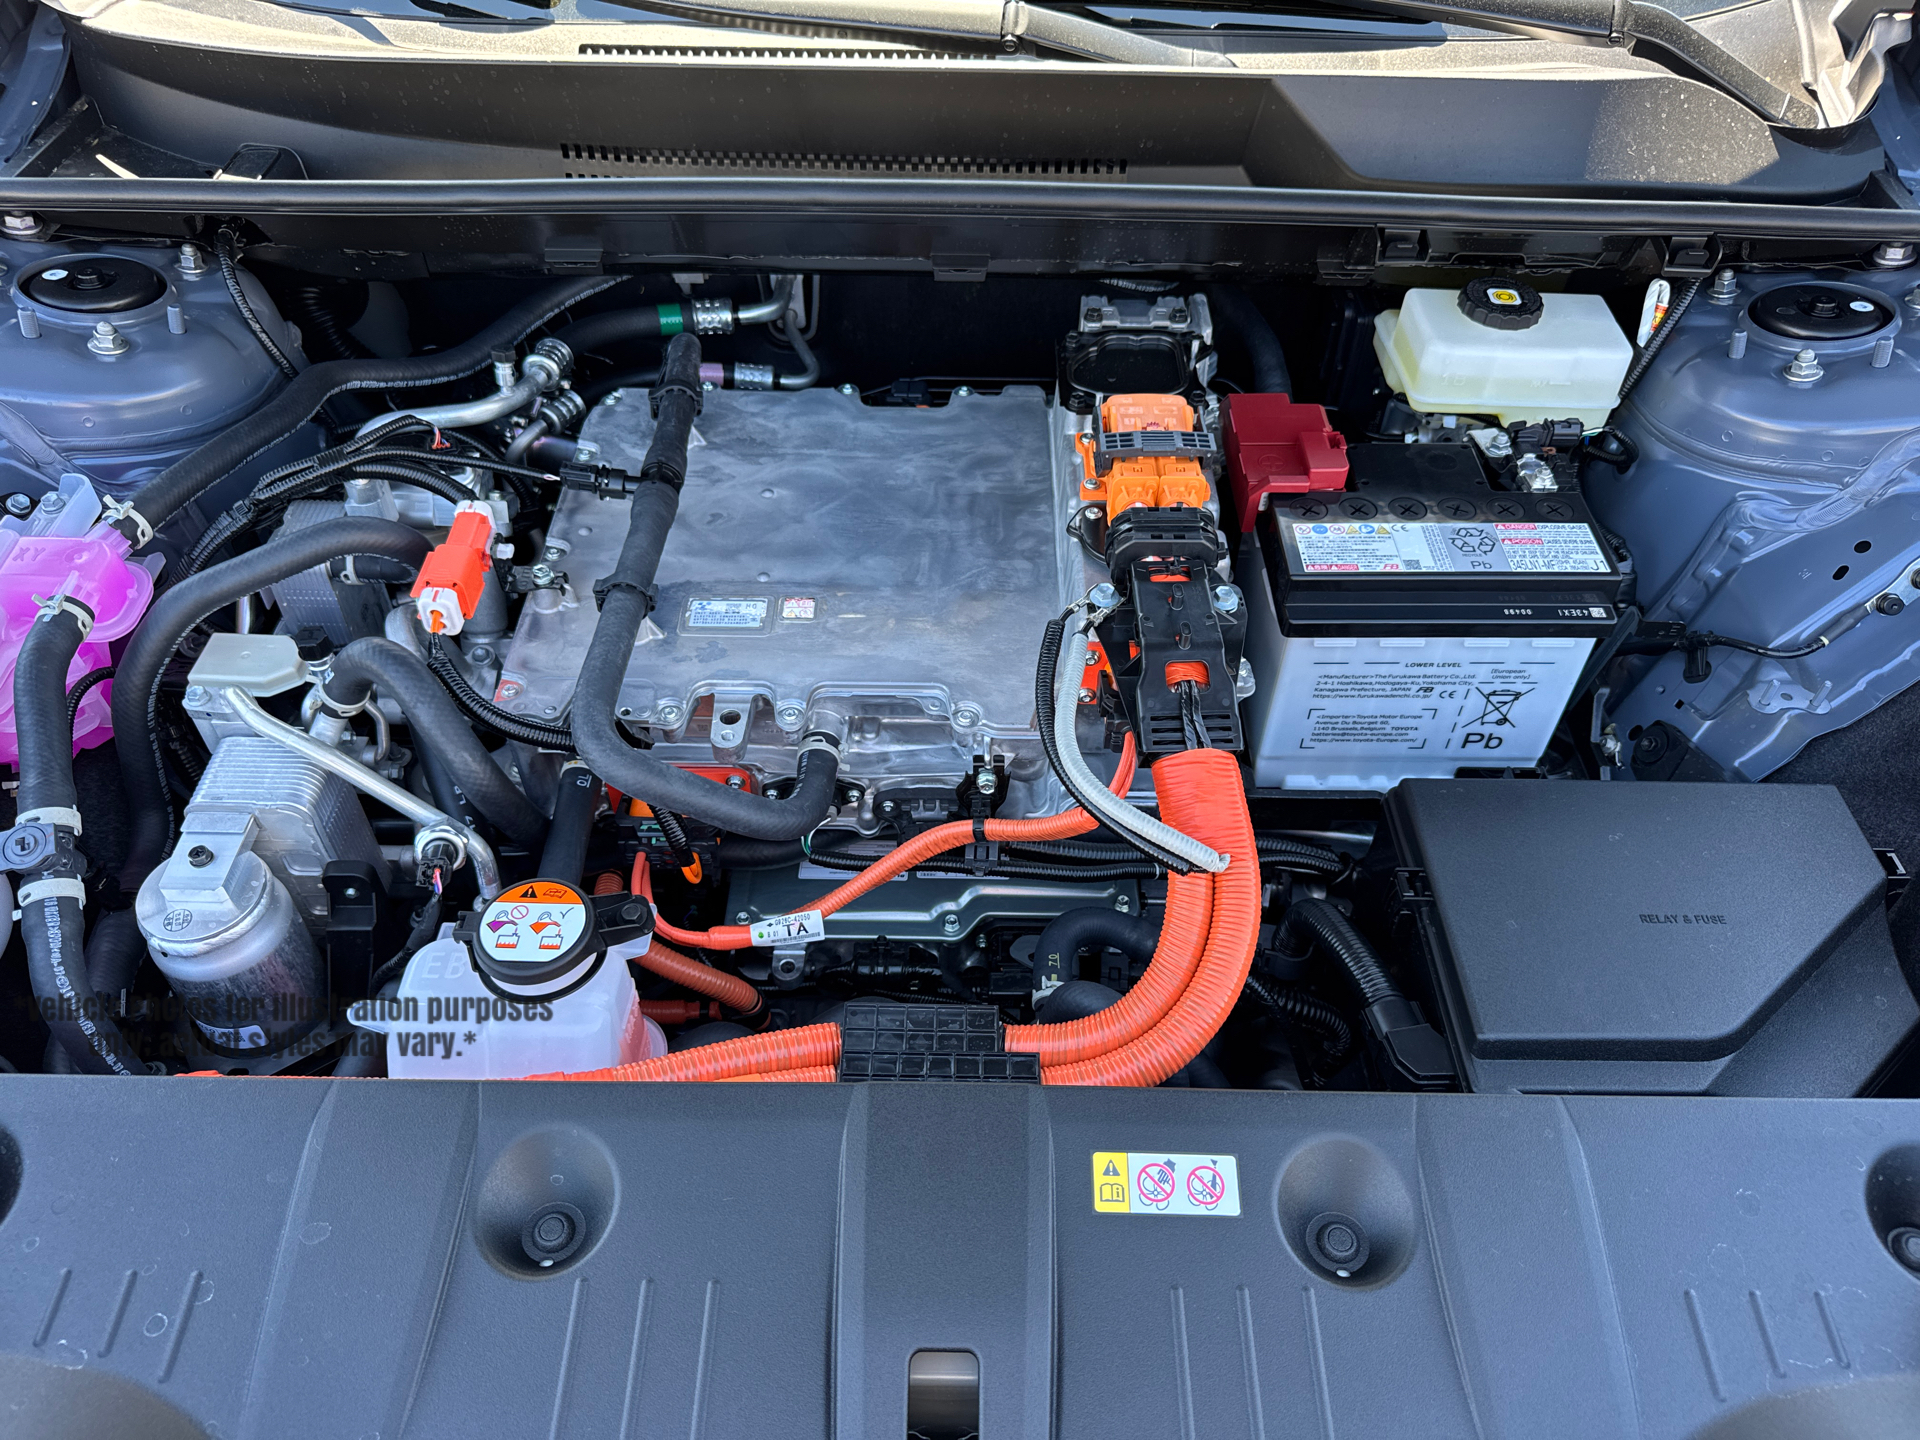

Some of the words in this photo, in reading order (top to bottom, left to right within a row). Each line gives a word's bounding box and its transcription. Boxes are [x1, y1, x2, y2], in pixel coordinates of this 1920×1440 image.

[1470, 560, 1493, 570] Pb
[1461, 732, 1503, 750] Pb
[1639, 914, 1679, 924] RELAY
[1683, 914, 1693, 924] &
[1694, 914, 1728, 925] FUSE
[782, 922, 809, 937] TA
